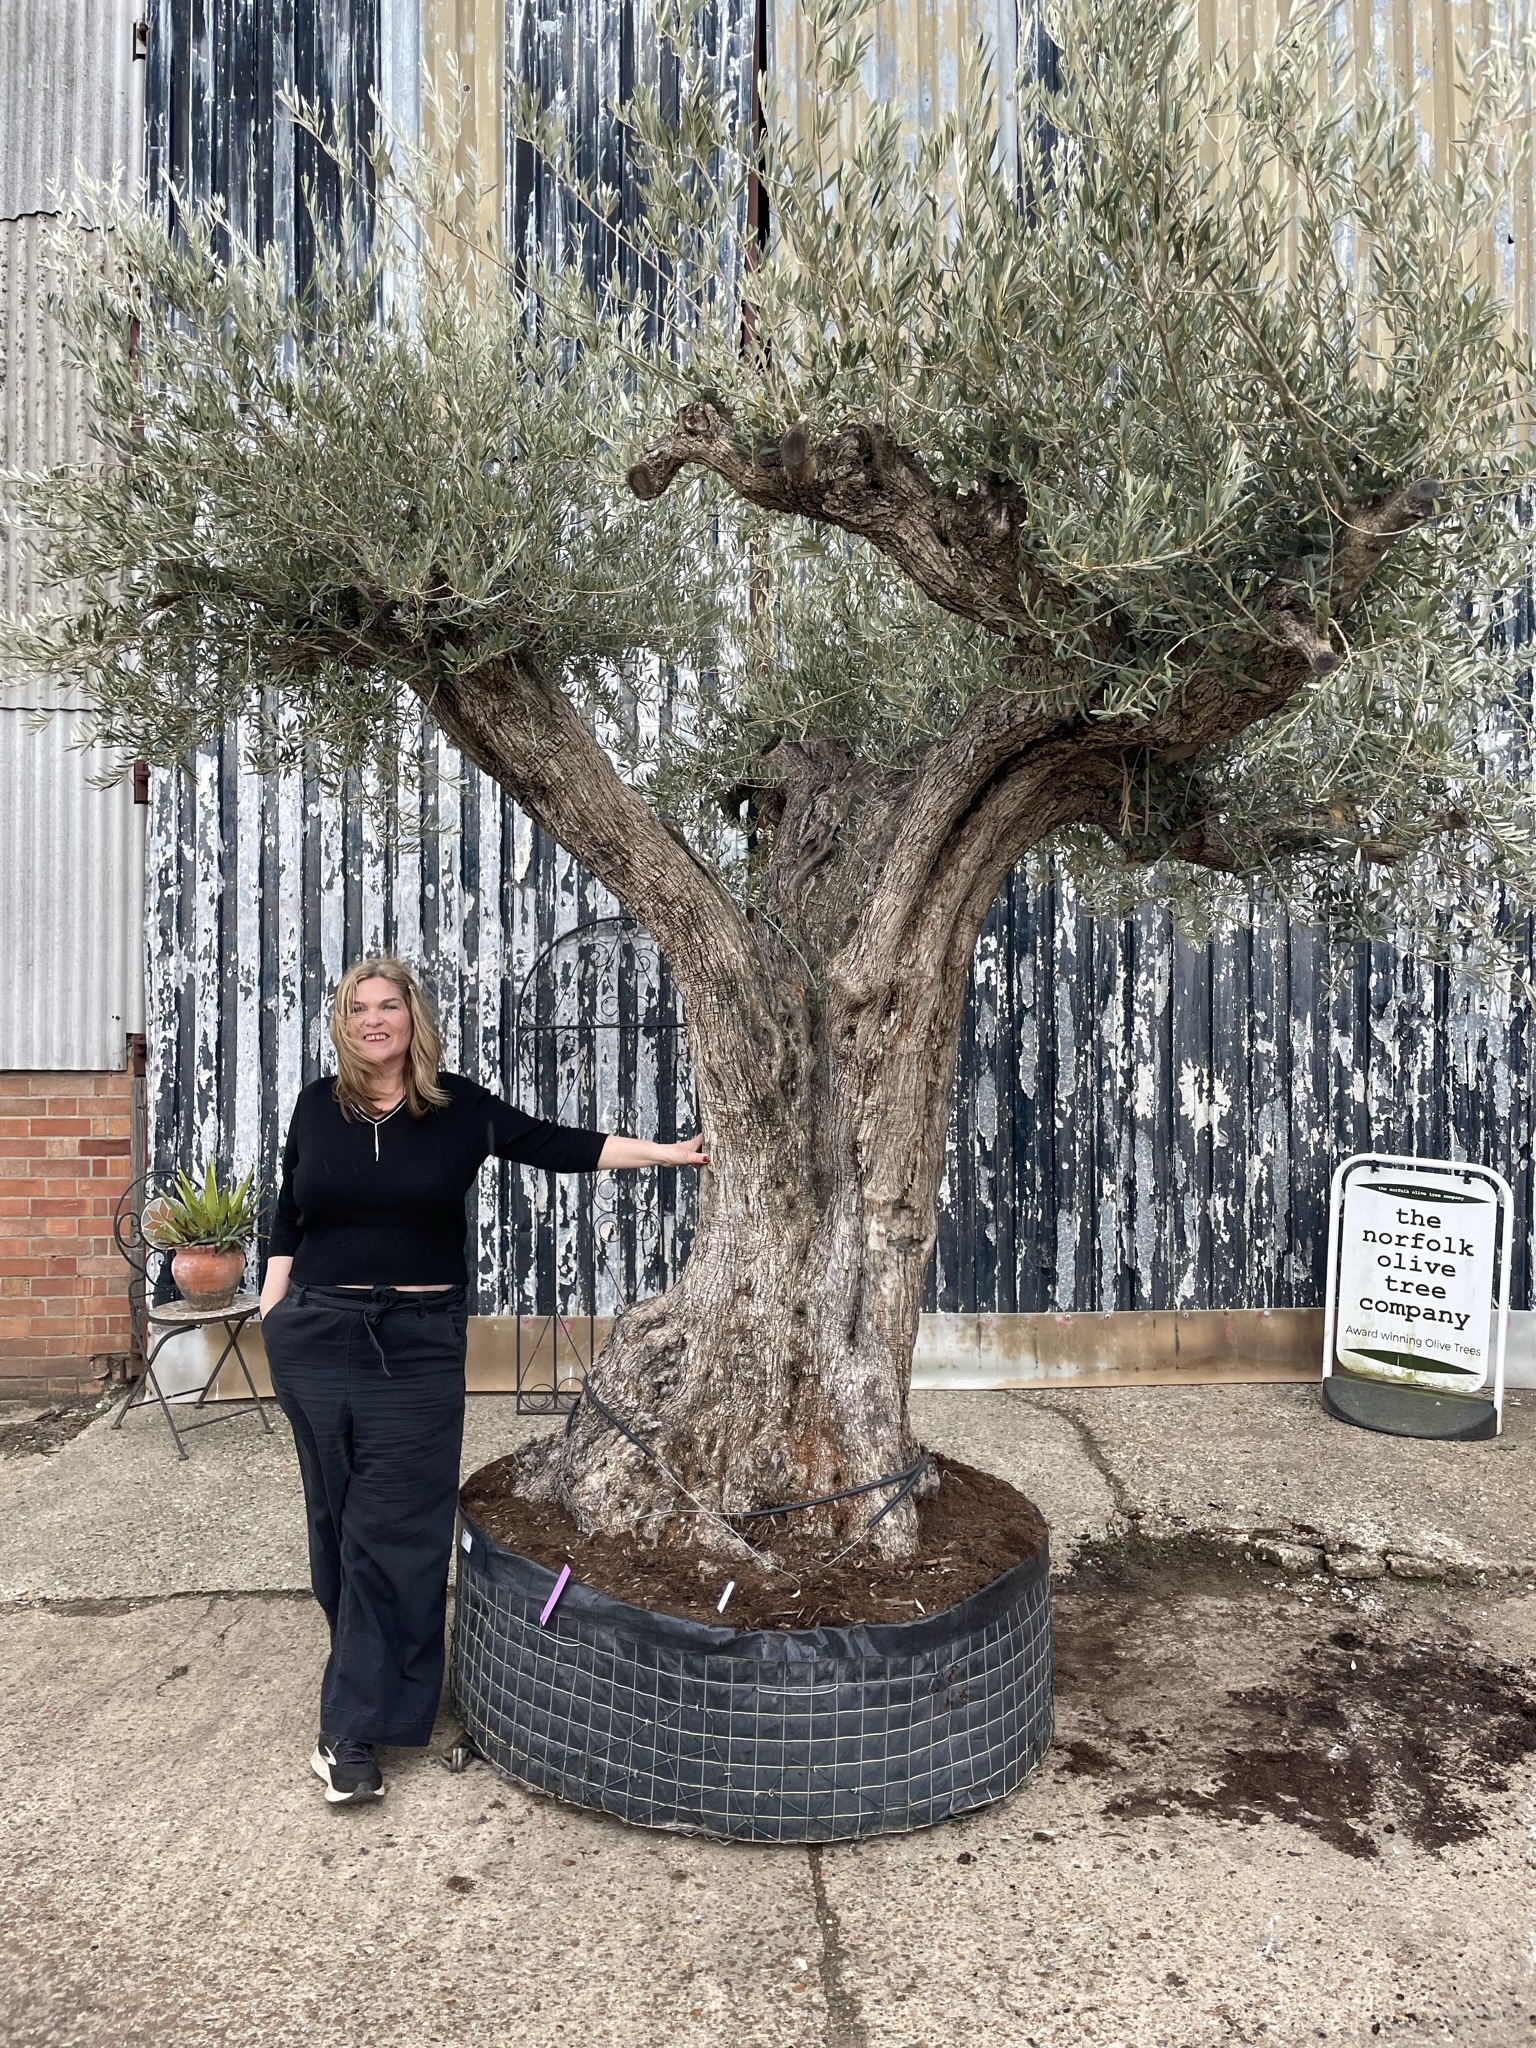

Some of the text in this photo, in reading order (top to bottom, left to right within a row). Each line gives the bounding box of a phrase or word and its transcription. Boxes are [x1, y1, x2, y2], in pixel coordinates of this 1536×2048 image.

[1396, 1208, 1441, 1229] the
[1362, 1229, 1474, 1257] norfolk
[1377, 1253, 1456, 1278] olive
[1384, 1275, 1446, 1299] tree
[1359, 1297, 1471, 1331] company
[1345, 1325, 1481, 1357] Award winning Olive Trees
